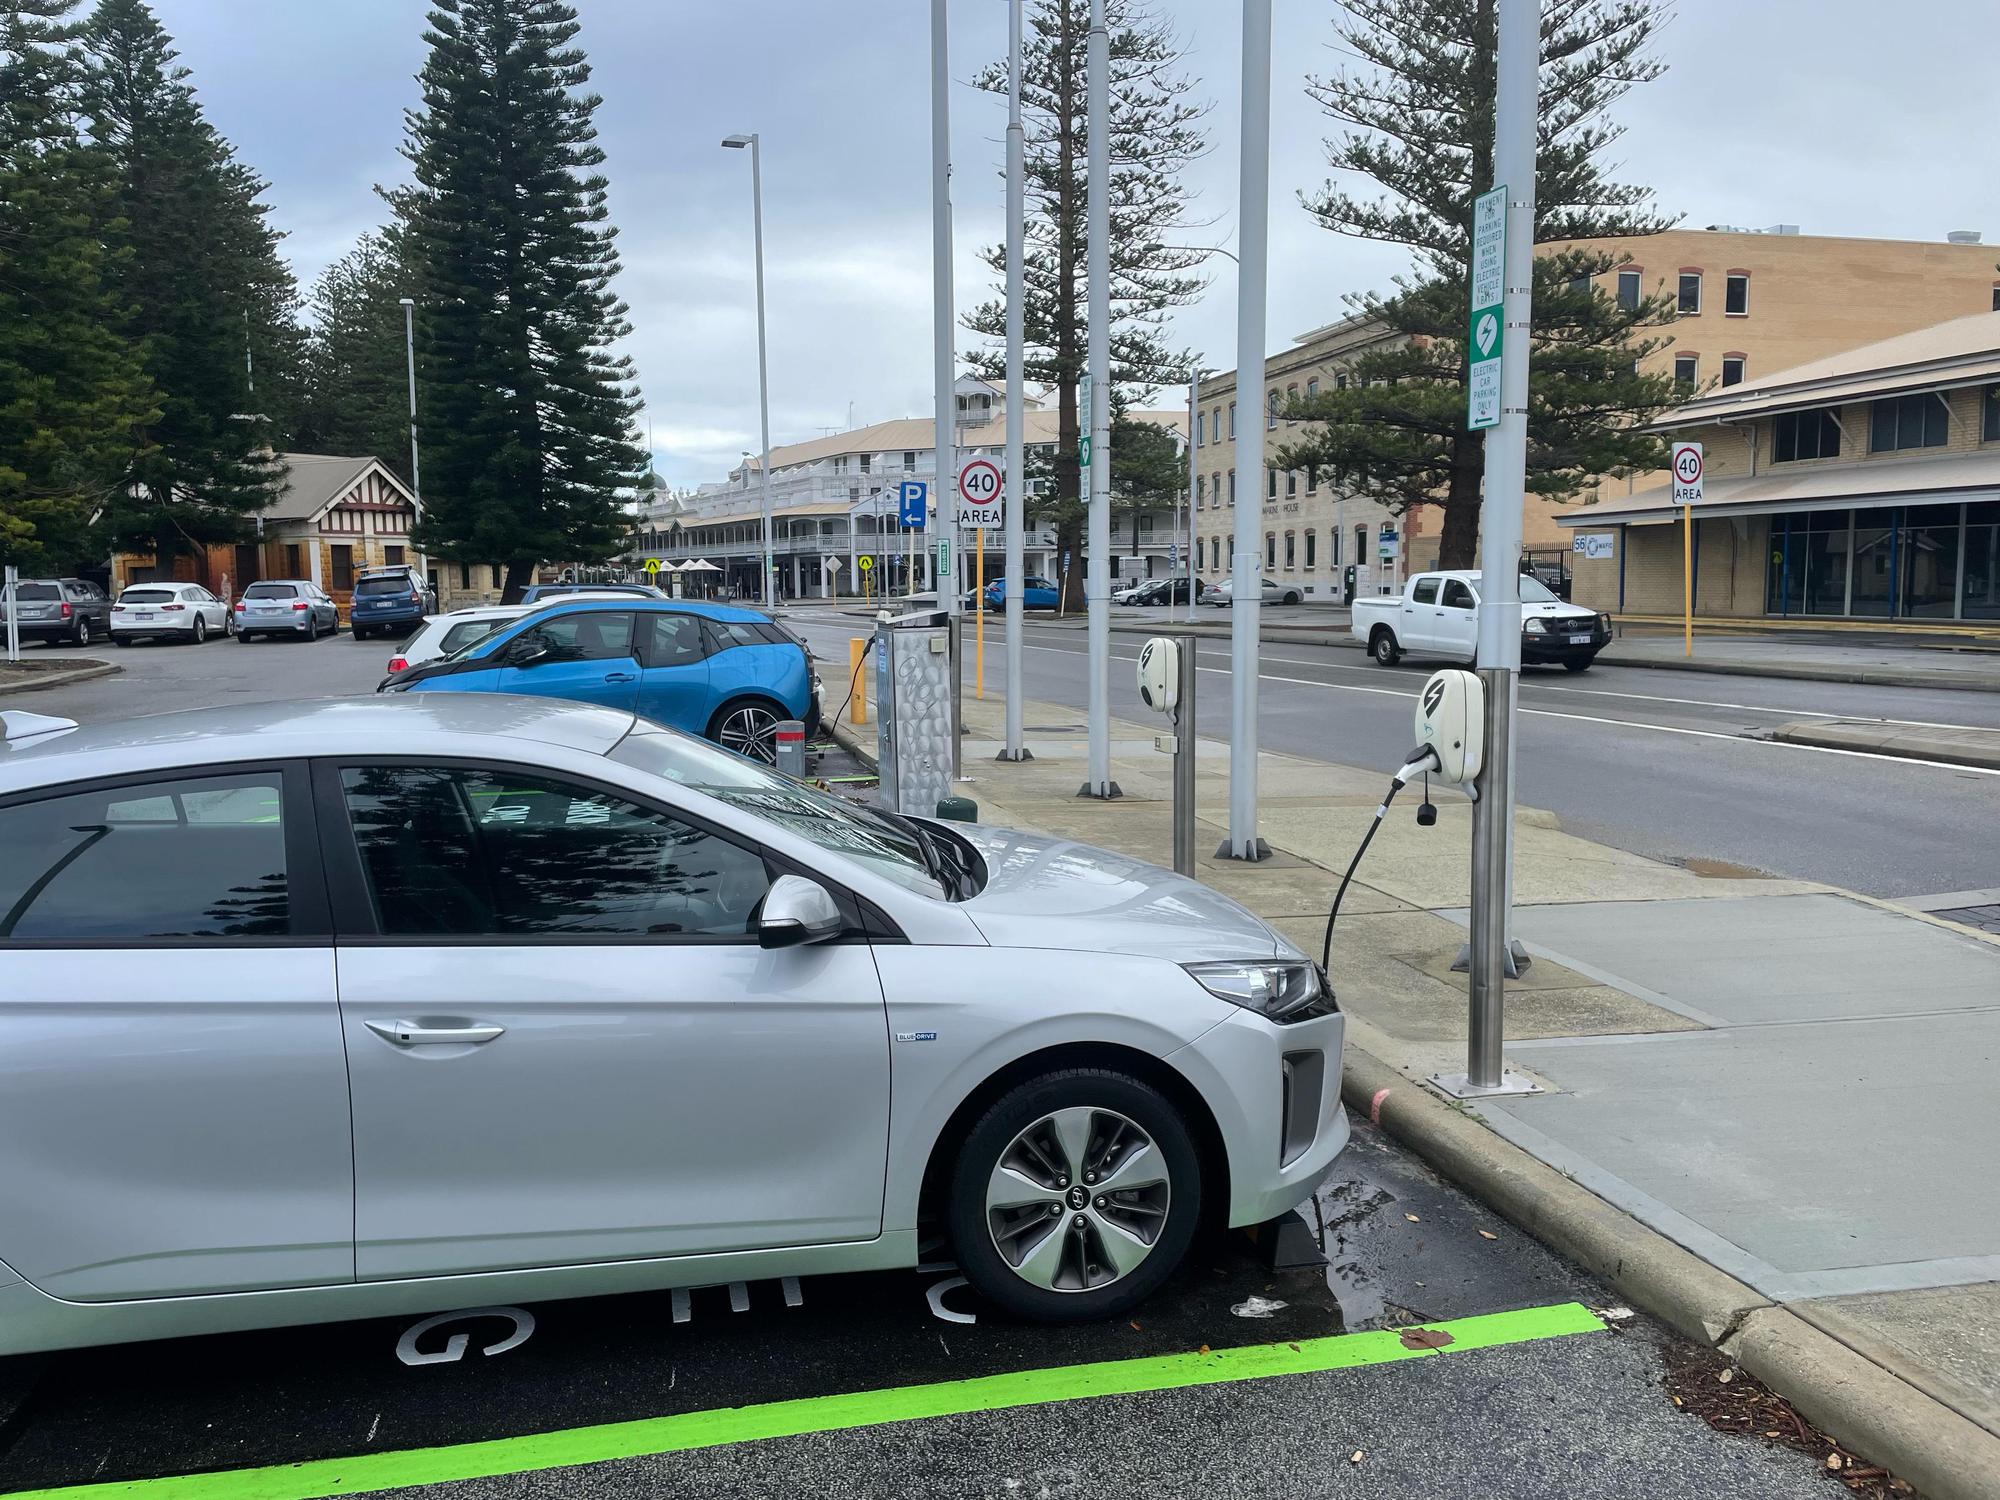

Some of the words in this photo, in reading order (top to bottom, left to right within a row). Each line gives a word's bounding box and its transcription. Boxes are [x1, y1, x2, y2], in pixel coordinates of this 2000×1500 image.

[1478, 192, 1503, 212] PAYMENT
[1485, 208, 1495, 221] FOR
[1478, 217, 1502, 235] PARKING
[1476, 230, 1503, 248] REQUIRED
[1481, 244, 1497, 257] WHEN
[1481, 255, 1497, 270] USING
[1476, 266, 1501, 283] ELECTRIC
[1477, 278, 1499, 293] VEHICLE
[1473, 362, 1499, 378] ELECTRIC
[1480, 376, 1491, 387] CAR
[1473, 386, 1497, 400] PARKING
[1477, 400, 1492, 411] ONLY
[1679, 458, 1698, 474] 40
[966, 473, 994, 492] 40
[905, 484, 923, 510] P
[1675, 488, 1702, 500] AREA
[961, 509, 1001, 523] AREA
[1575, 537, 1585, 550] 56
